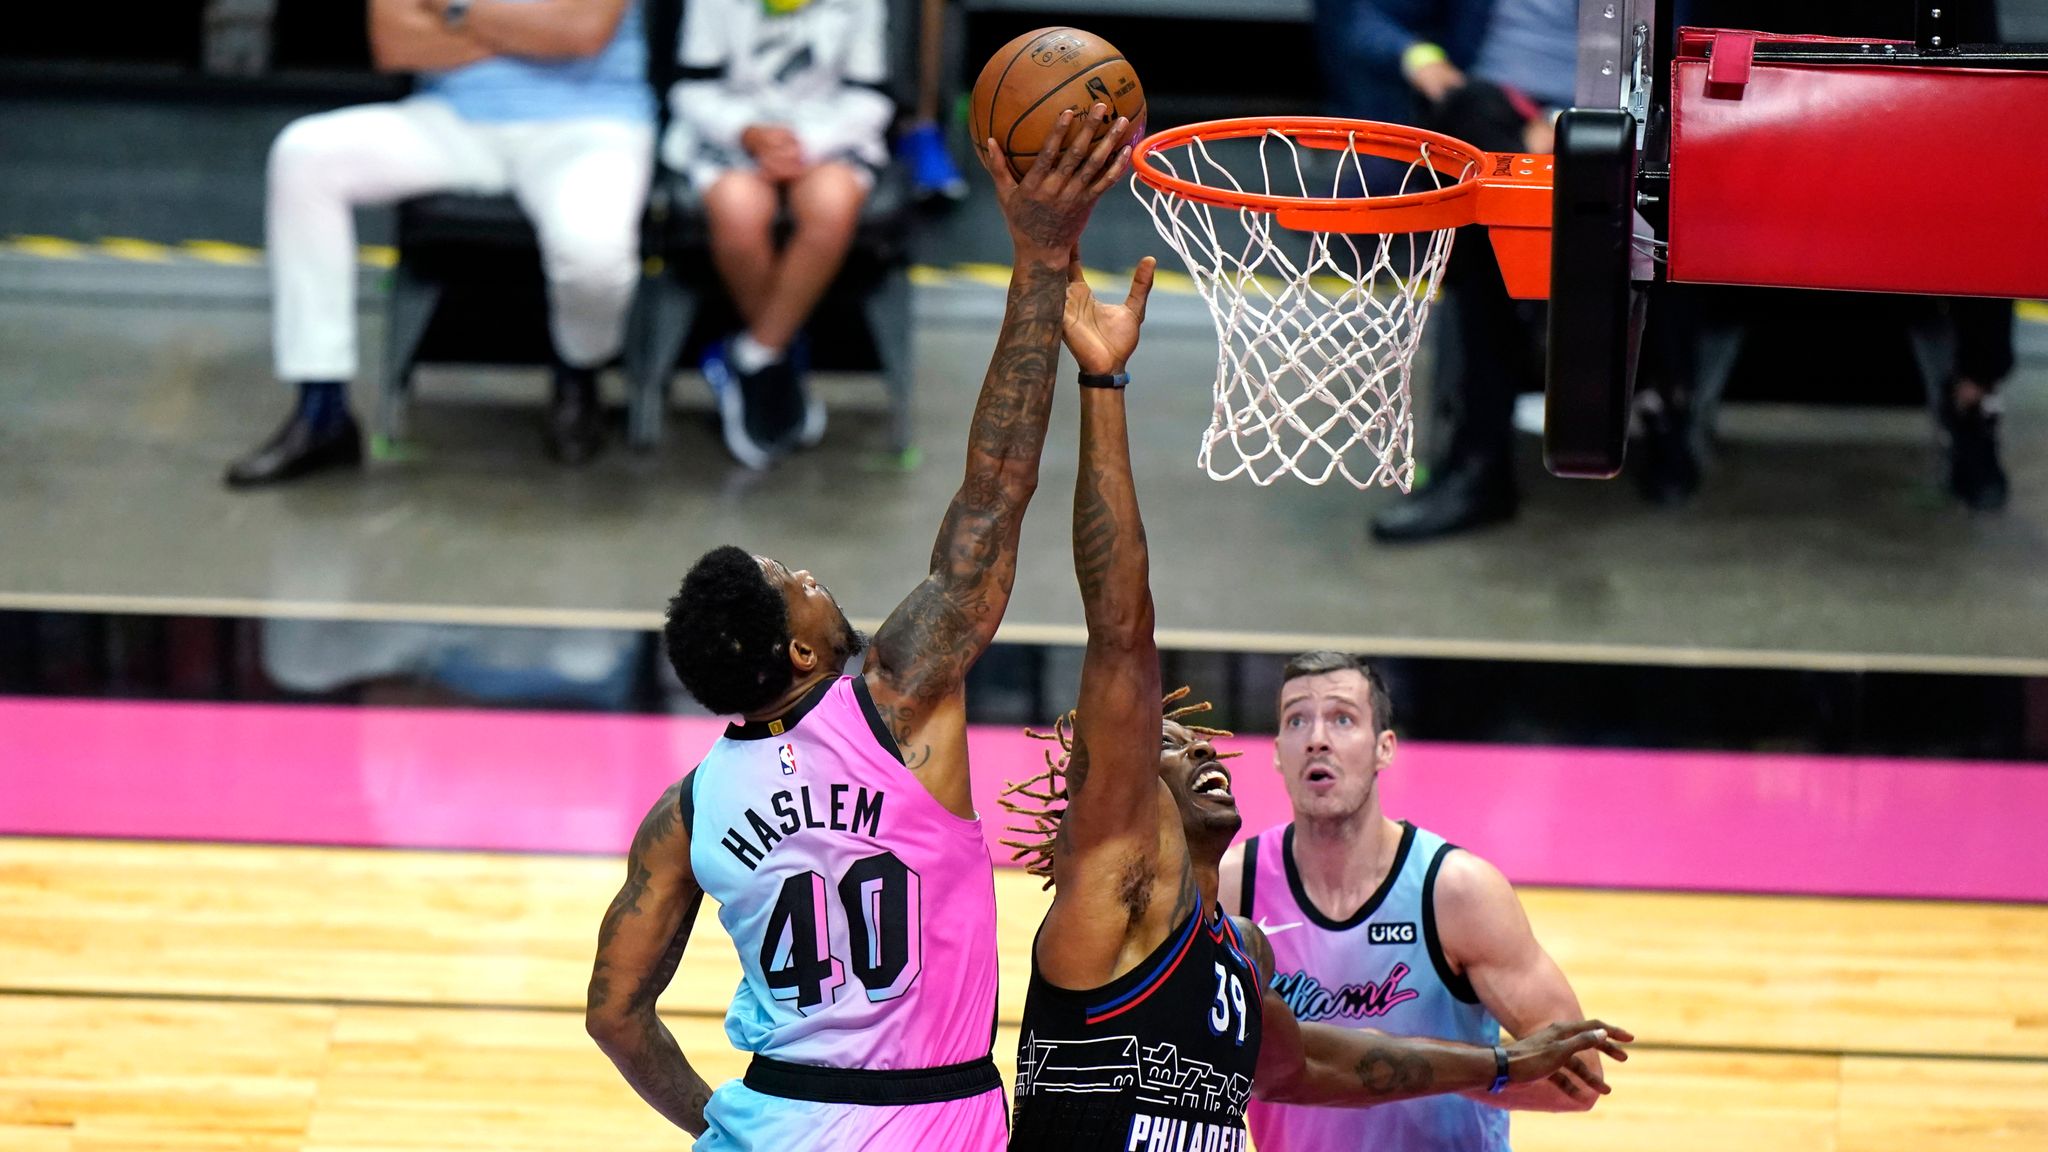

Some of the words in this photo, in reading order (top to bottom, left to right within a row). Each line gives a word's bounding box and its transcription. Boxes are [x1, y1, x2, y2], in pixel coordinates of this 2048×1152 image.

[721, 783, 885, 872] HASLEM
[759, 851, 922, 1017] 40
[1208, 960, 1248, 1046] 39
